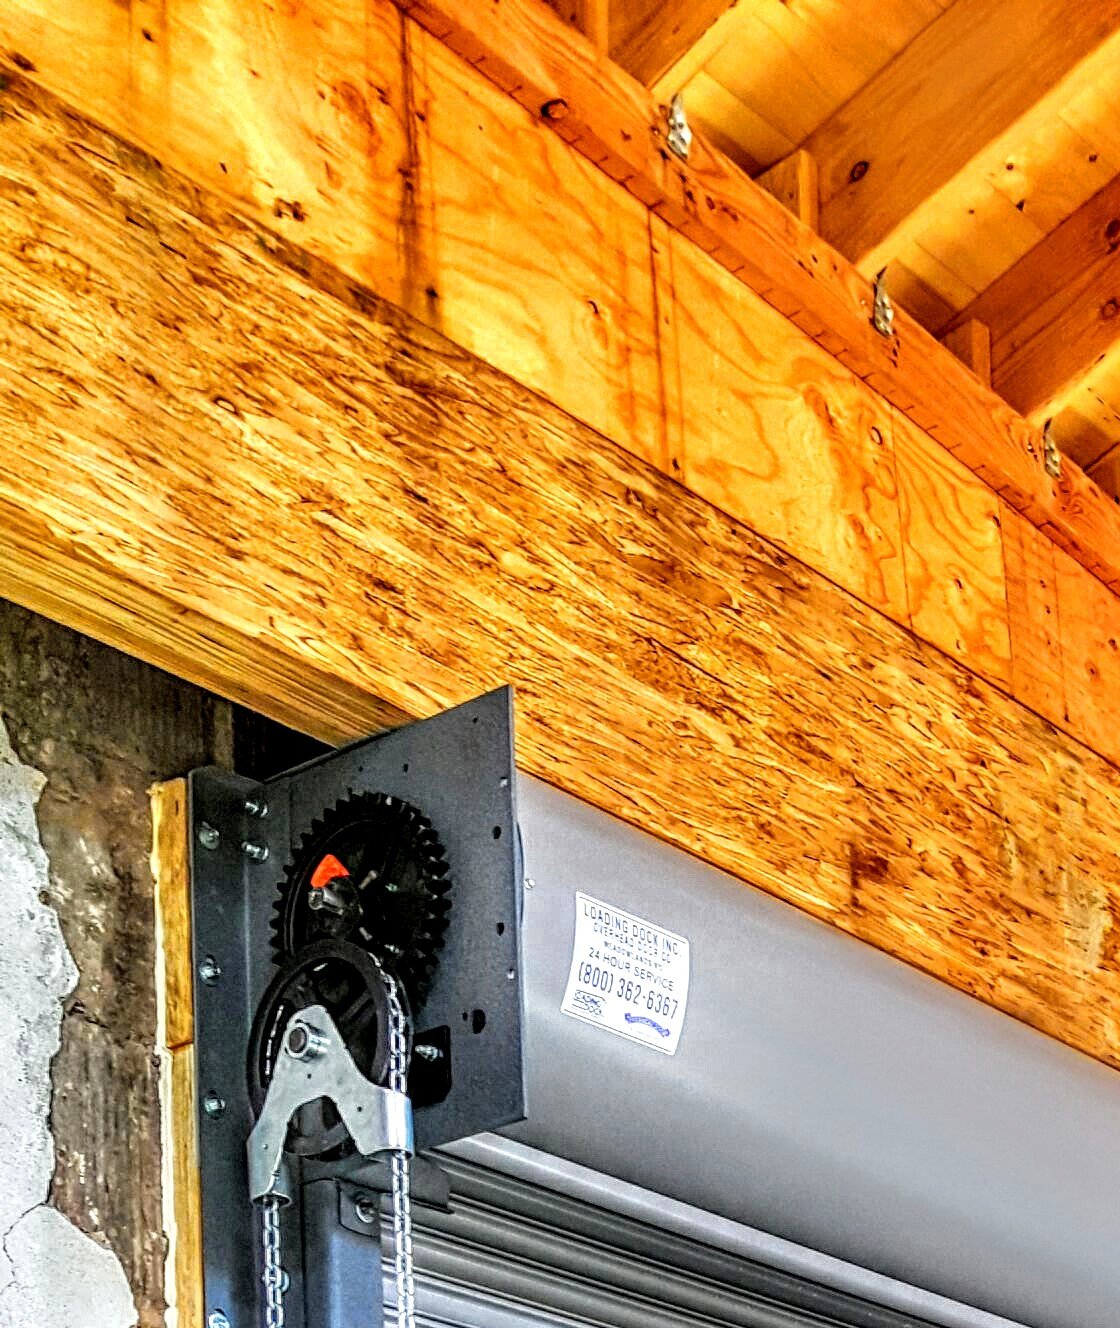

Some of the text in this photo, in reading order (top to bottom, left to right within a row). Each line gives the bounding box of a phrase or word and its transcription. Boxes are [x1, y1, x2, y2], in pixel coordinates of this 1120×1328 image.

[583, 902, 629, 933] LOADING
[632, 924, 659, 946] DOCK
[578, 961, 614, 994] (800)
[616, 977, 679, 1020] 362-6367
[588, 946, 600, 960] 24
[602, 953, 631, 973] HOUR
[633, 966, 675, 992] SERVICE
